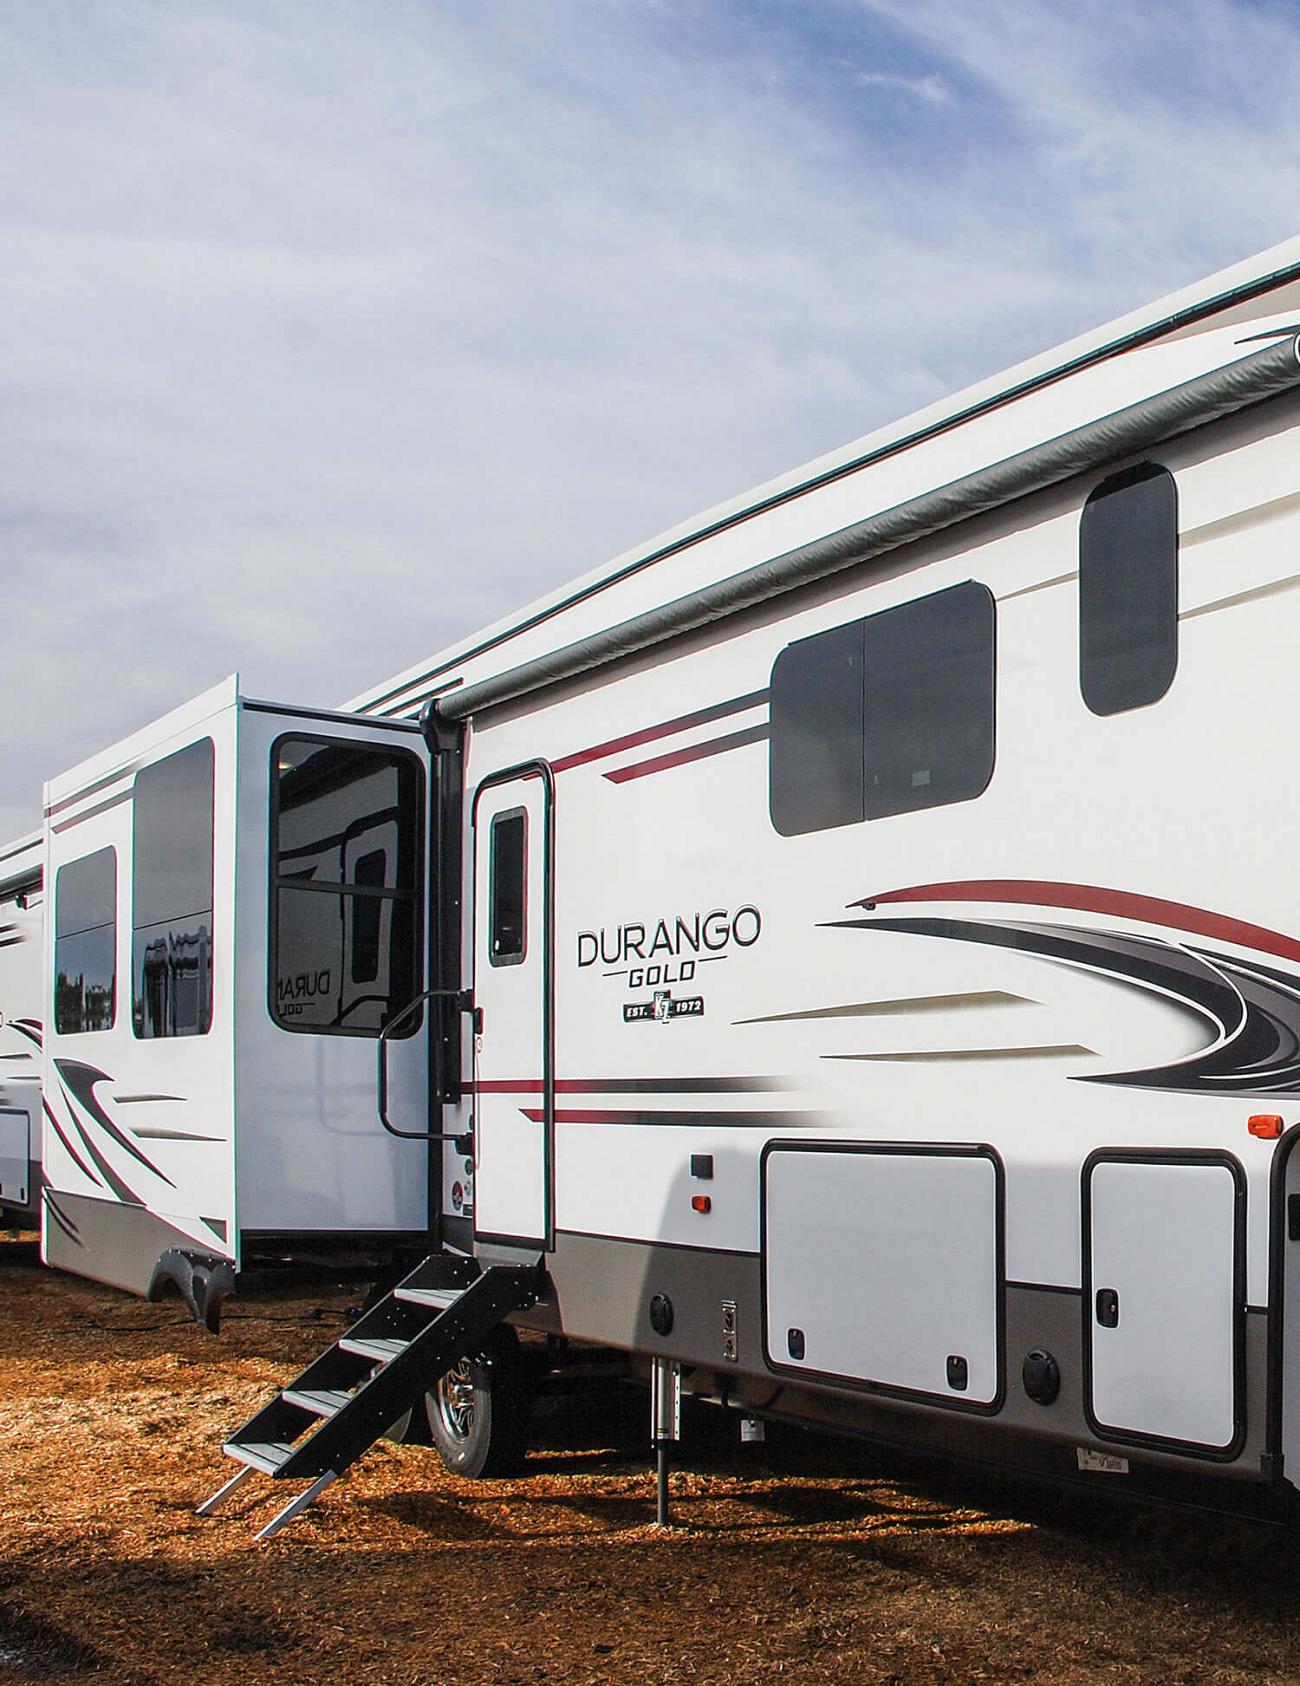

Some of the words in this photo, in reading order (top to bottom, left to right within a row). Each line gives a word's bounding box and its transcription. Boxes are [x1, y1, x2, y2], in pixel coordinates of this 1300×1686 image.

[577, 903, 761, 967] DURANGO
[628, 960, 696, 988] GOLD
[626, 1006, 647, 1017] EST.
[675, 1001, 702, 1013] 1972
